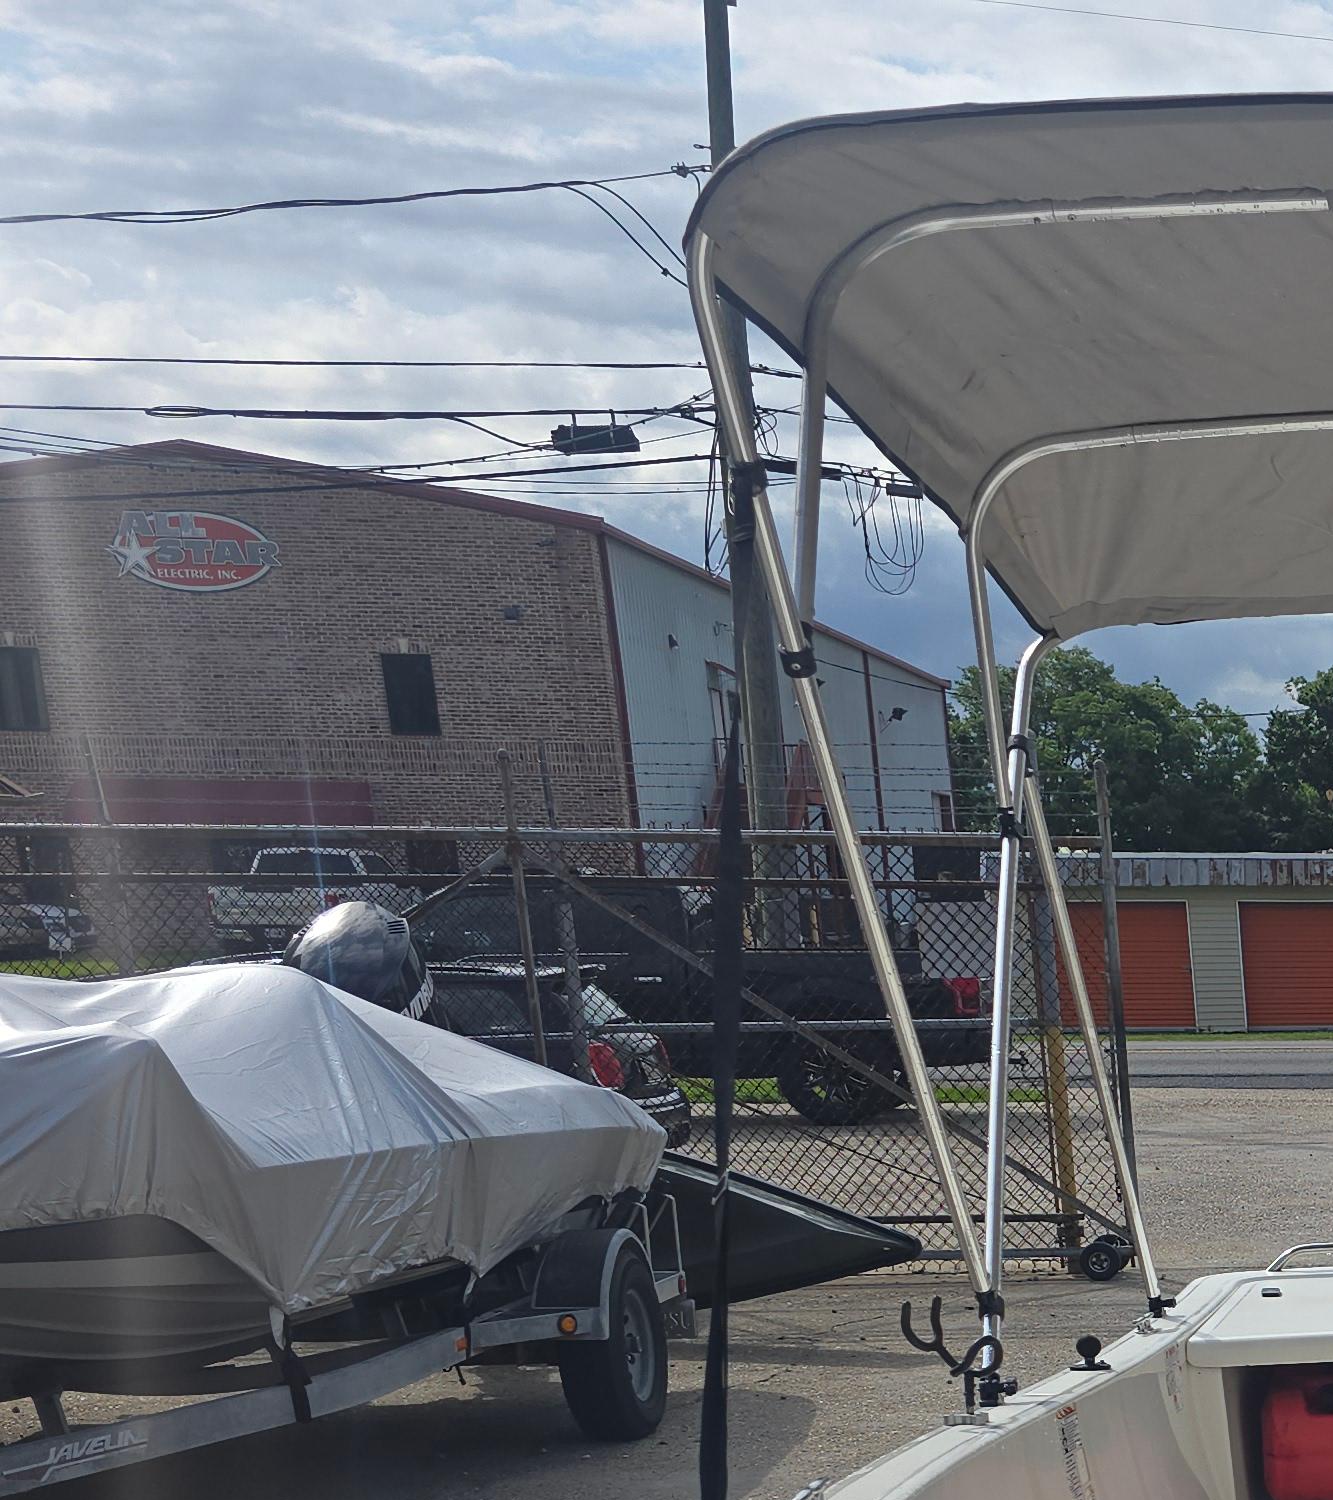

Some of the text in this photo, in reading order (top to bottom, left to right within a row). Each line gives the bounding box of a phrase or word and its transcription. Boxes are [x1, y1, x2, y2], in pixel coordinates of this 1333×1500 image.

[117, 511, 207, 537] ALL
[153, 538, 282, 566] STAR
[157, 567, 242, 580] ELECTRIC, INC.
[41, 1429, 148, 1468] JAVELIN
